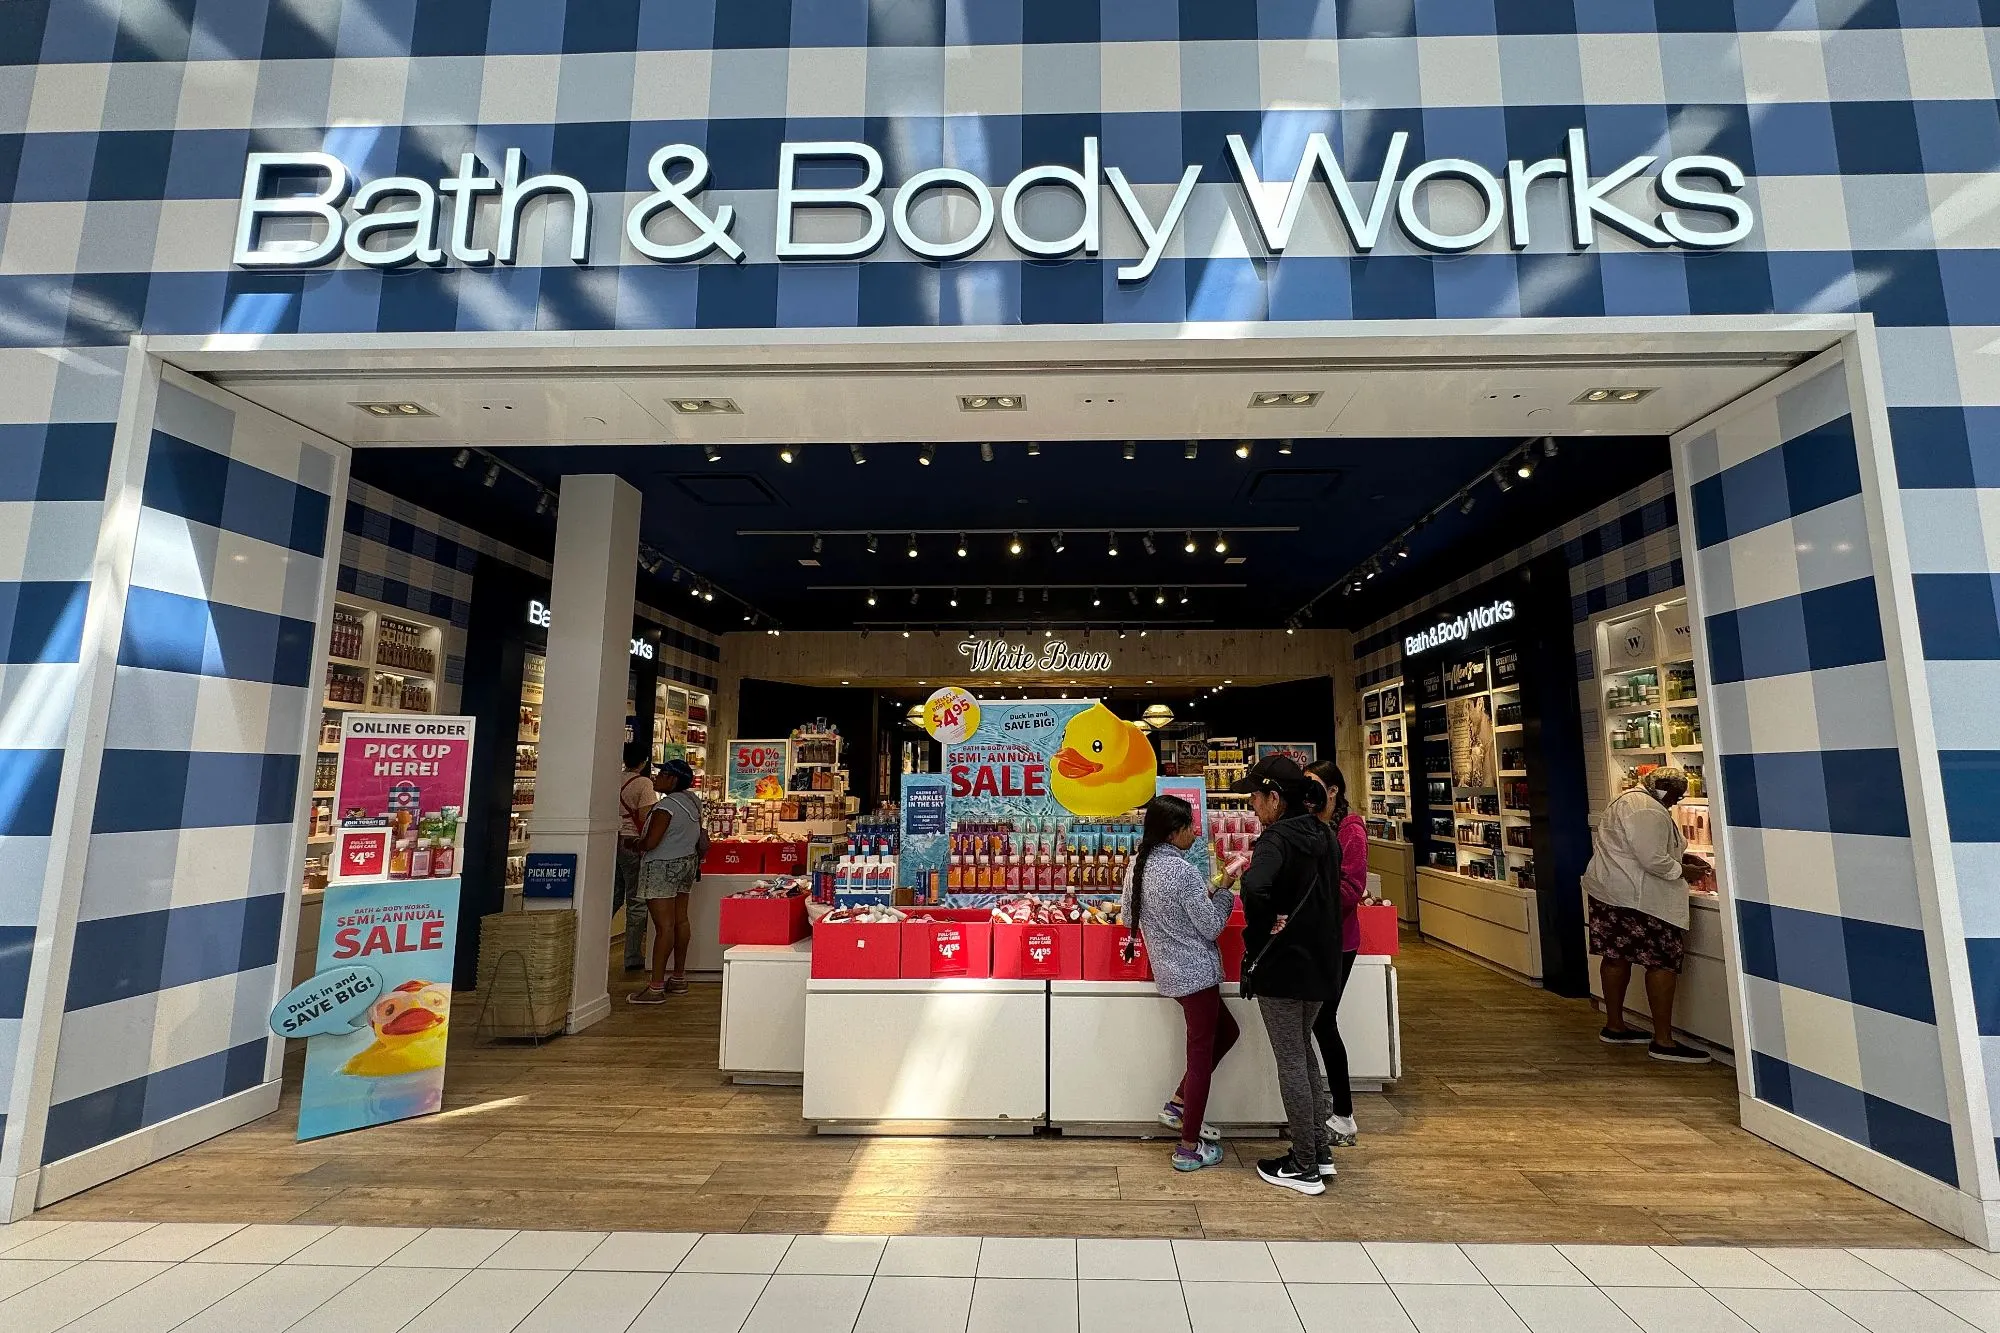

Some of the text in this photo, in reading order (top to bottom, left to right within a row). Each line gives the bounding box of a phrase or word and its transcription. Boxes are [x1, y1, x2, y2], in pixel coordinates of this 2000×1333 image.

[234, 128, 1755, 282] Bath & Body Works
[529, 600, 550, 627] Ba
[1405, 600, 1514, 656] Bath & Body Works
[958, 640, 1111, 672] White Barn
[934, 692, 951, 705] SELECT
[352, 722, 466, 736] ONLINE ORDER
[1004, 718, 1055, 730] SAVE BIG!
[364, 743, 451, 759] PICK UP
[948, 752, 1044, 763] SEMI-ANNUAL
[373, 762, 439, 776] HERE!
[950, 765, 1046, 797] SALE
[528, 868, 571, 877] PICK ME UP!
[336, 909, 445, 927] SEMI-ANNUAL
[354, 907, 374, 915] BATH
[382, 904, 403, 912] BODY
[332, 920, 445, 959] SALE
[287, 972, 358, 1014] Duck in and
[282, 976, 375, 1032] SAVE BIG!
